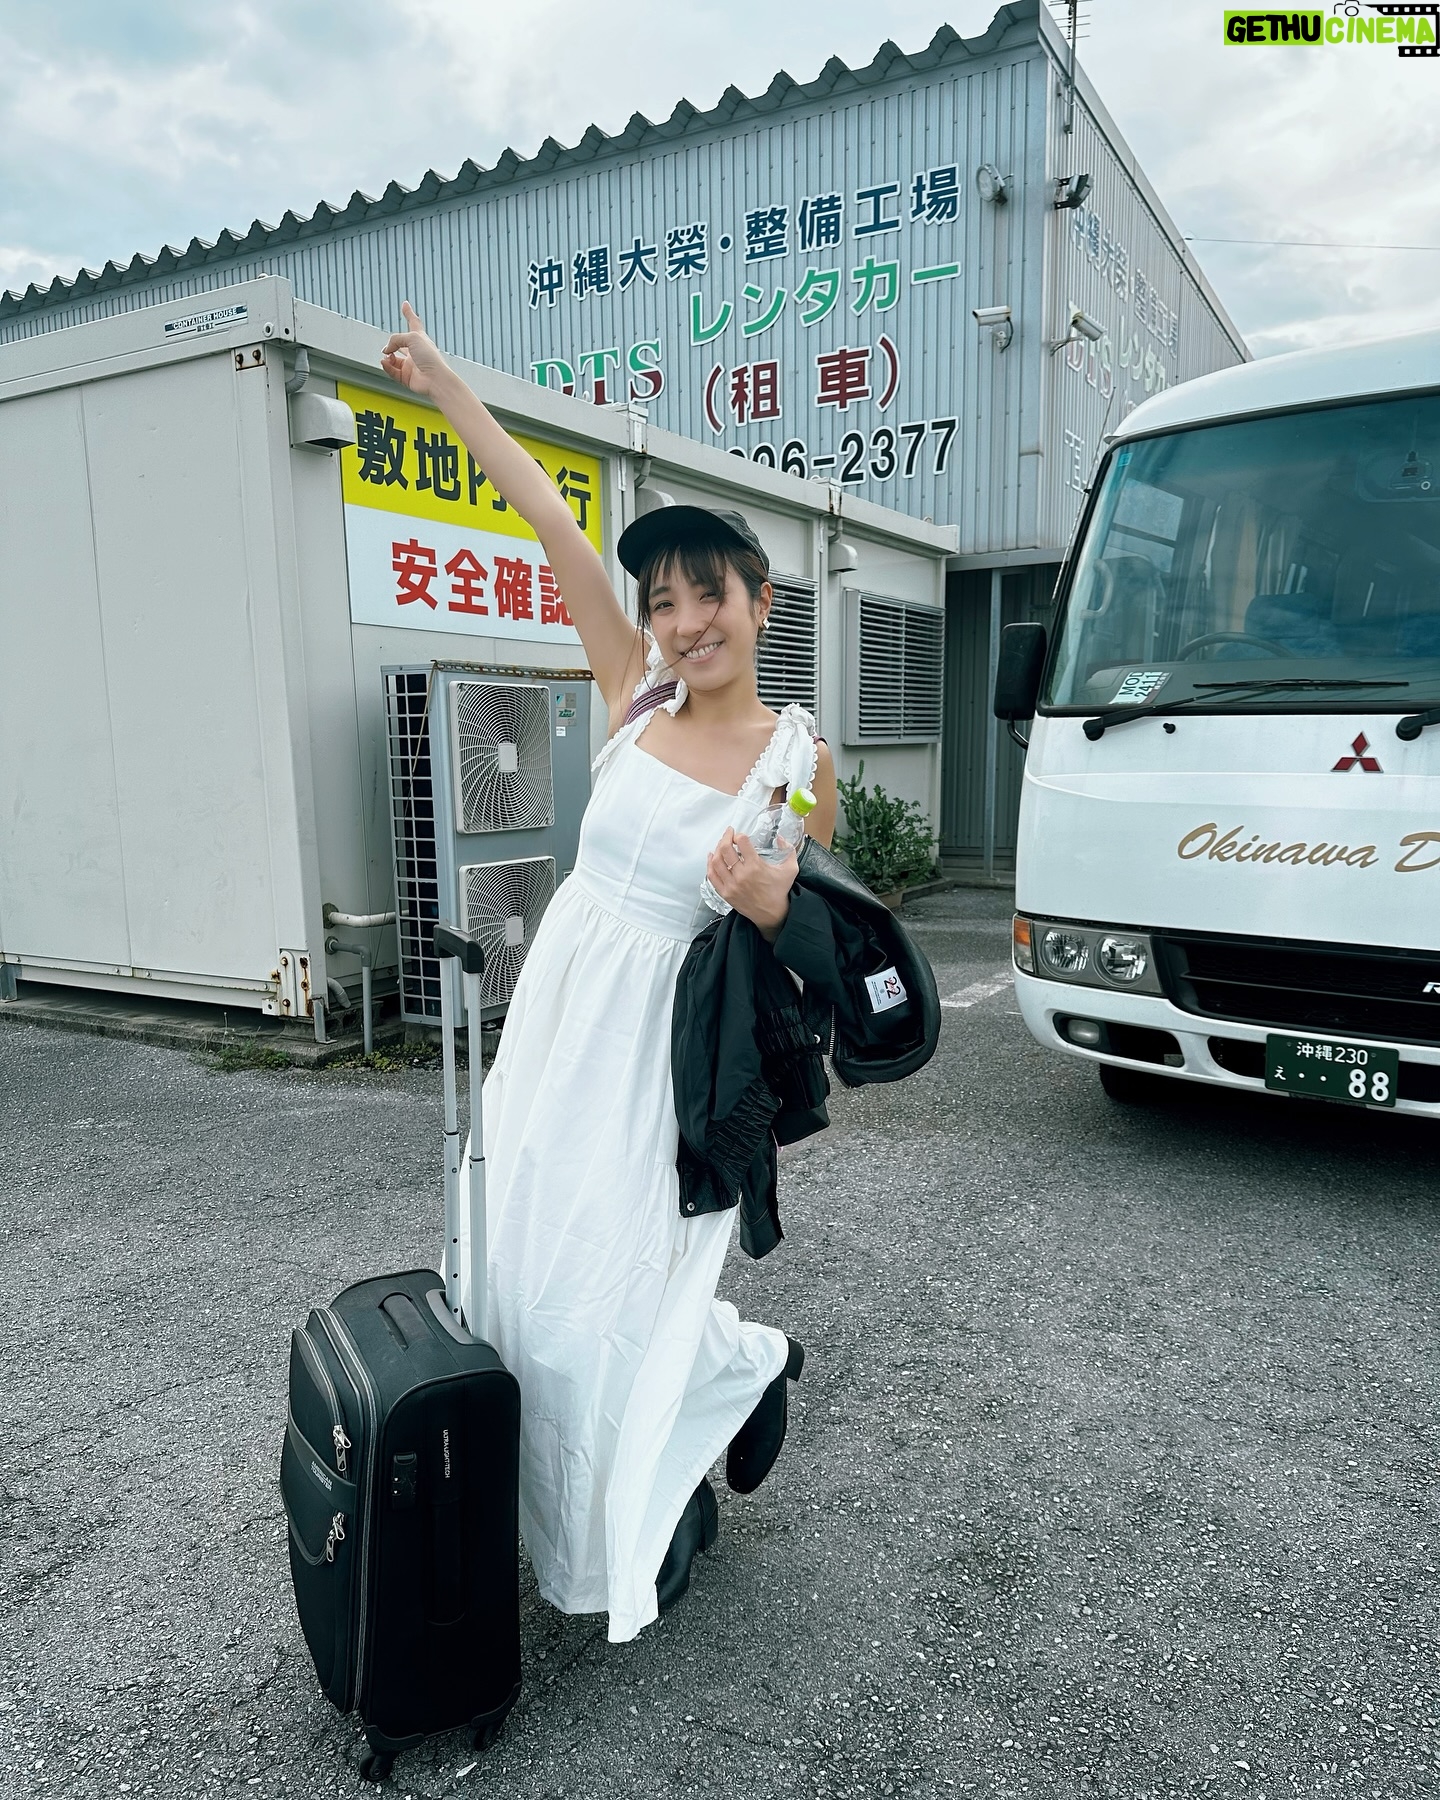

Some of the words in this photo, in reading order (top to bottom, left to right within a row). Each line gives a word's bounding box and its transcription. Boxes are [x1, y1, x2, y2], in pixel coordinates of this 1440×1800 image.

[213, 307, 238, 320] HOUSE
[690, 256, 961, 346] レンタカー
[530, 338, 664, 406] DTS
[355, 410, 592, 531] 敷地行
[728, 416, 959, 485] 6-2377
[1177, 822, 1379, 869] Okinawa
